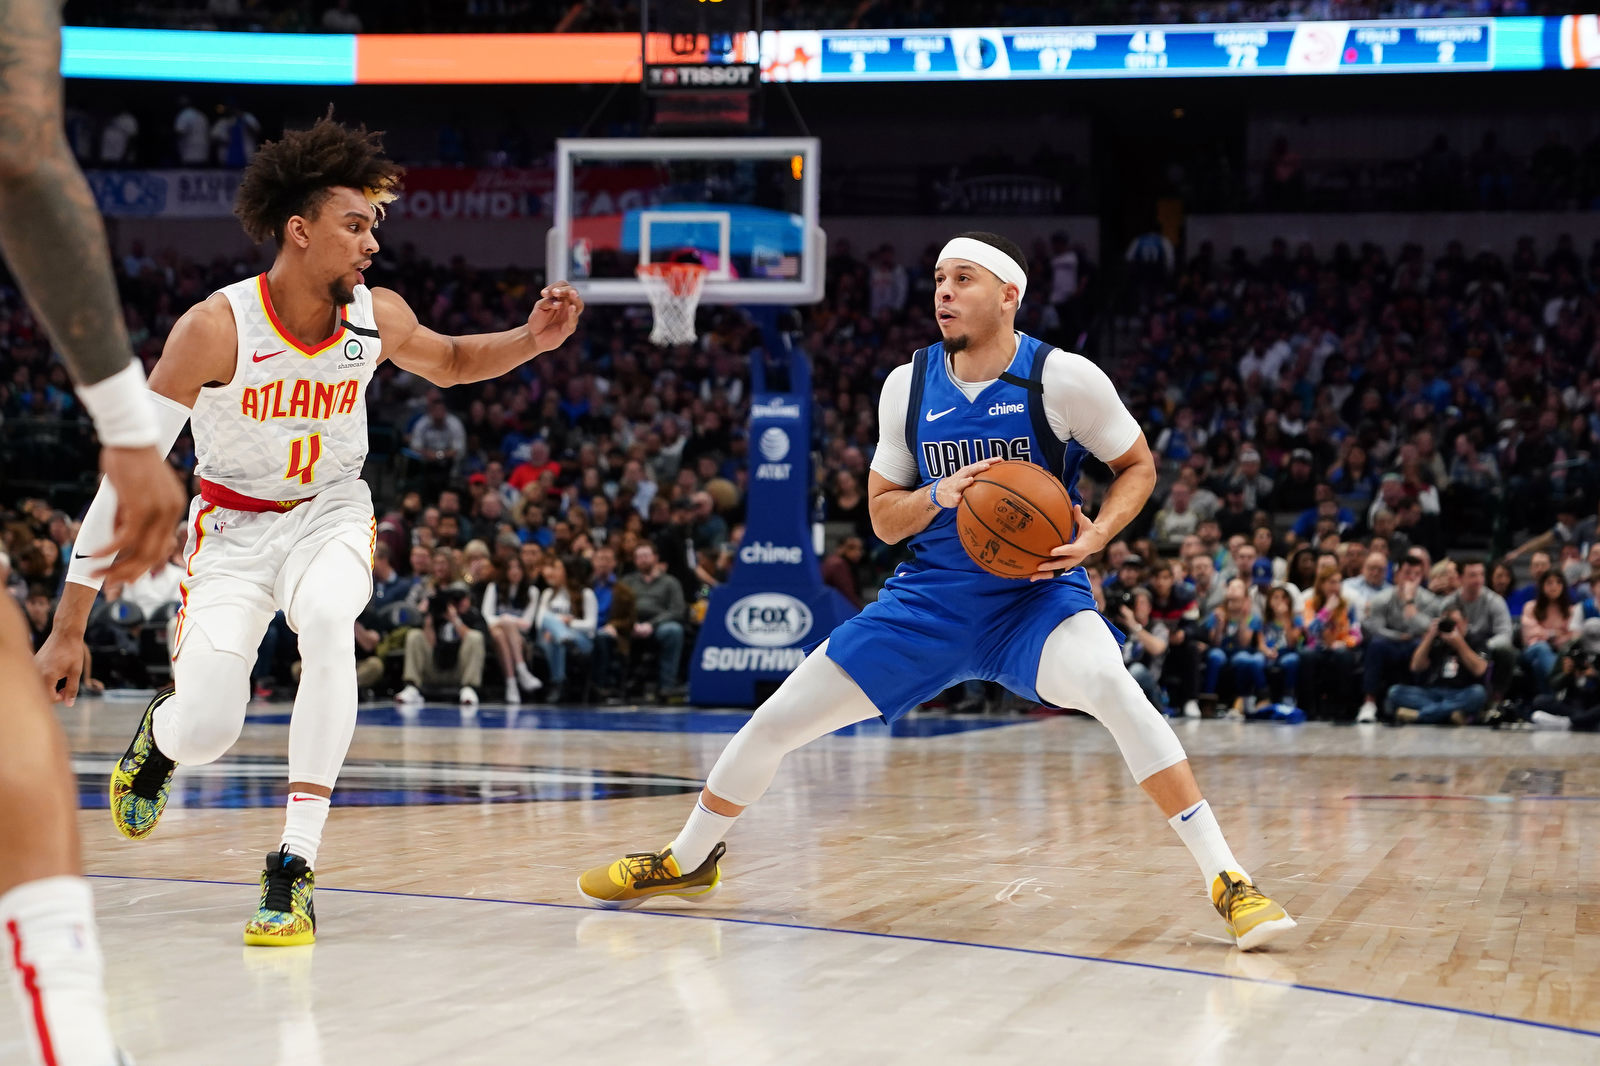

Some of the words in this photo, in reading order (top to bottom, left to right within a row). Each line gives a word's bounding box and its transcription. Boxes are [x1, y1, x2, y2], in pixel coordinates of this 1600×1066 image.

[680, 66, 753, 84] TISSOT
[338, 362, 366, 370] sharecare
[241, 378, 359, 423] ATLANTA
[988, 402, 1025, 416] chime
[283, 431, 322, 485] 4
[755, 463, 792, 480] AT&T
[739, 541, 803, 564] chime
[748, 606, 791, 624] FOX
